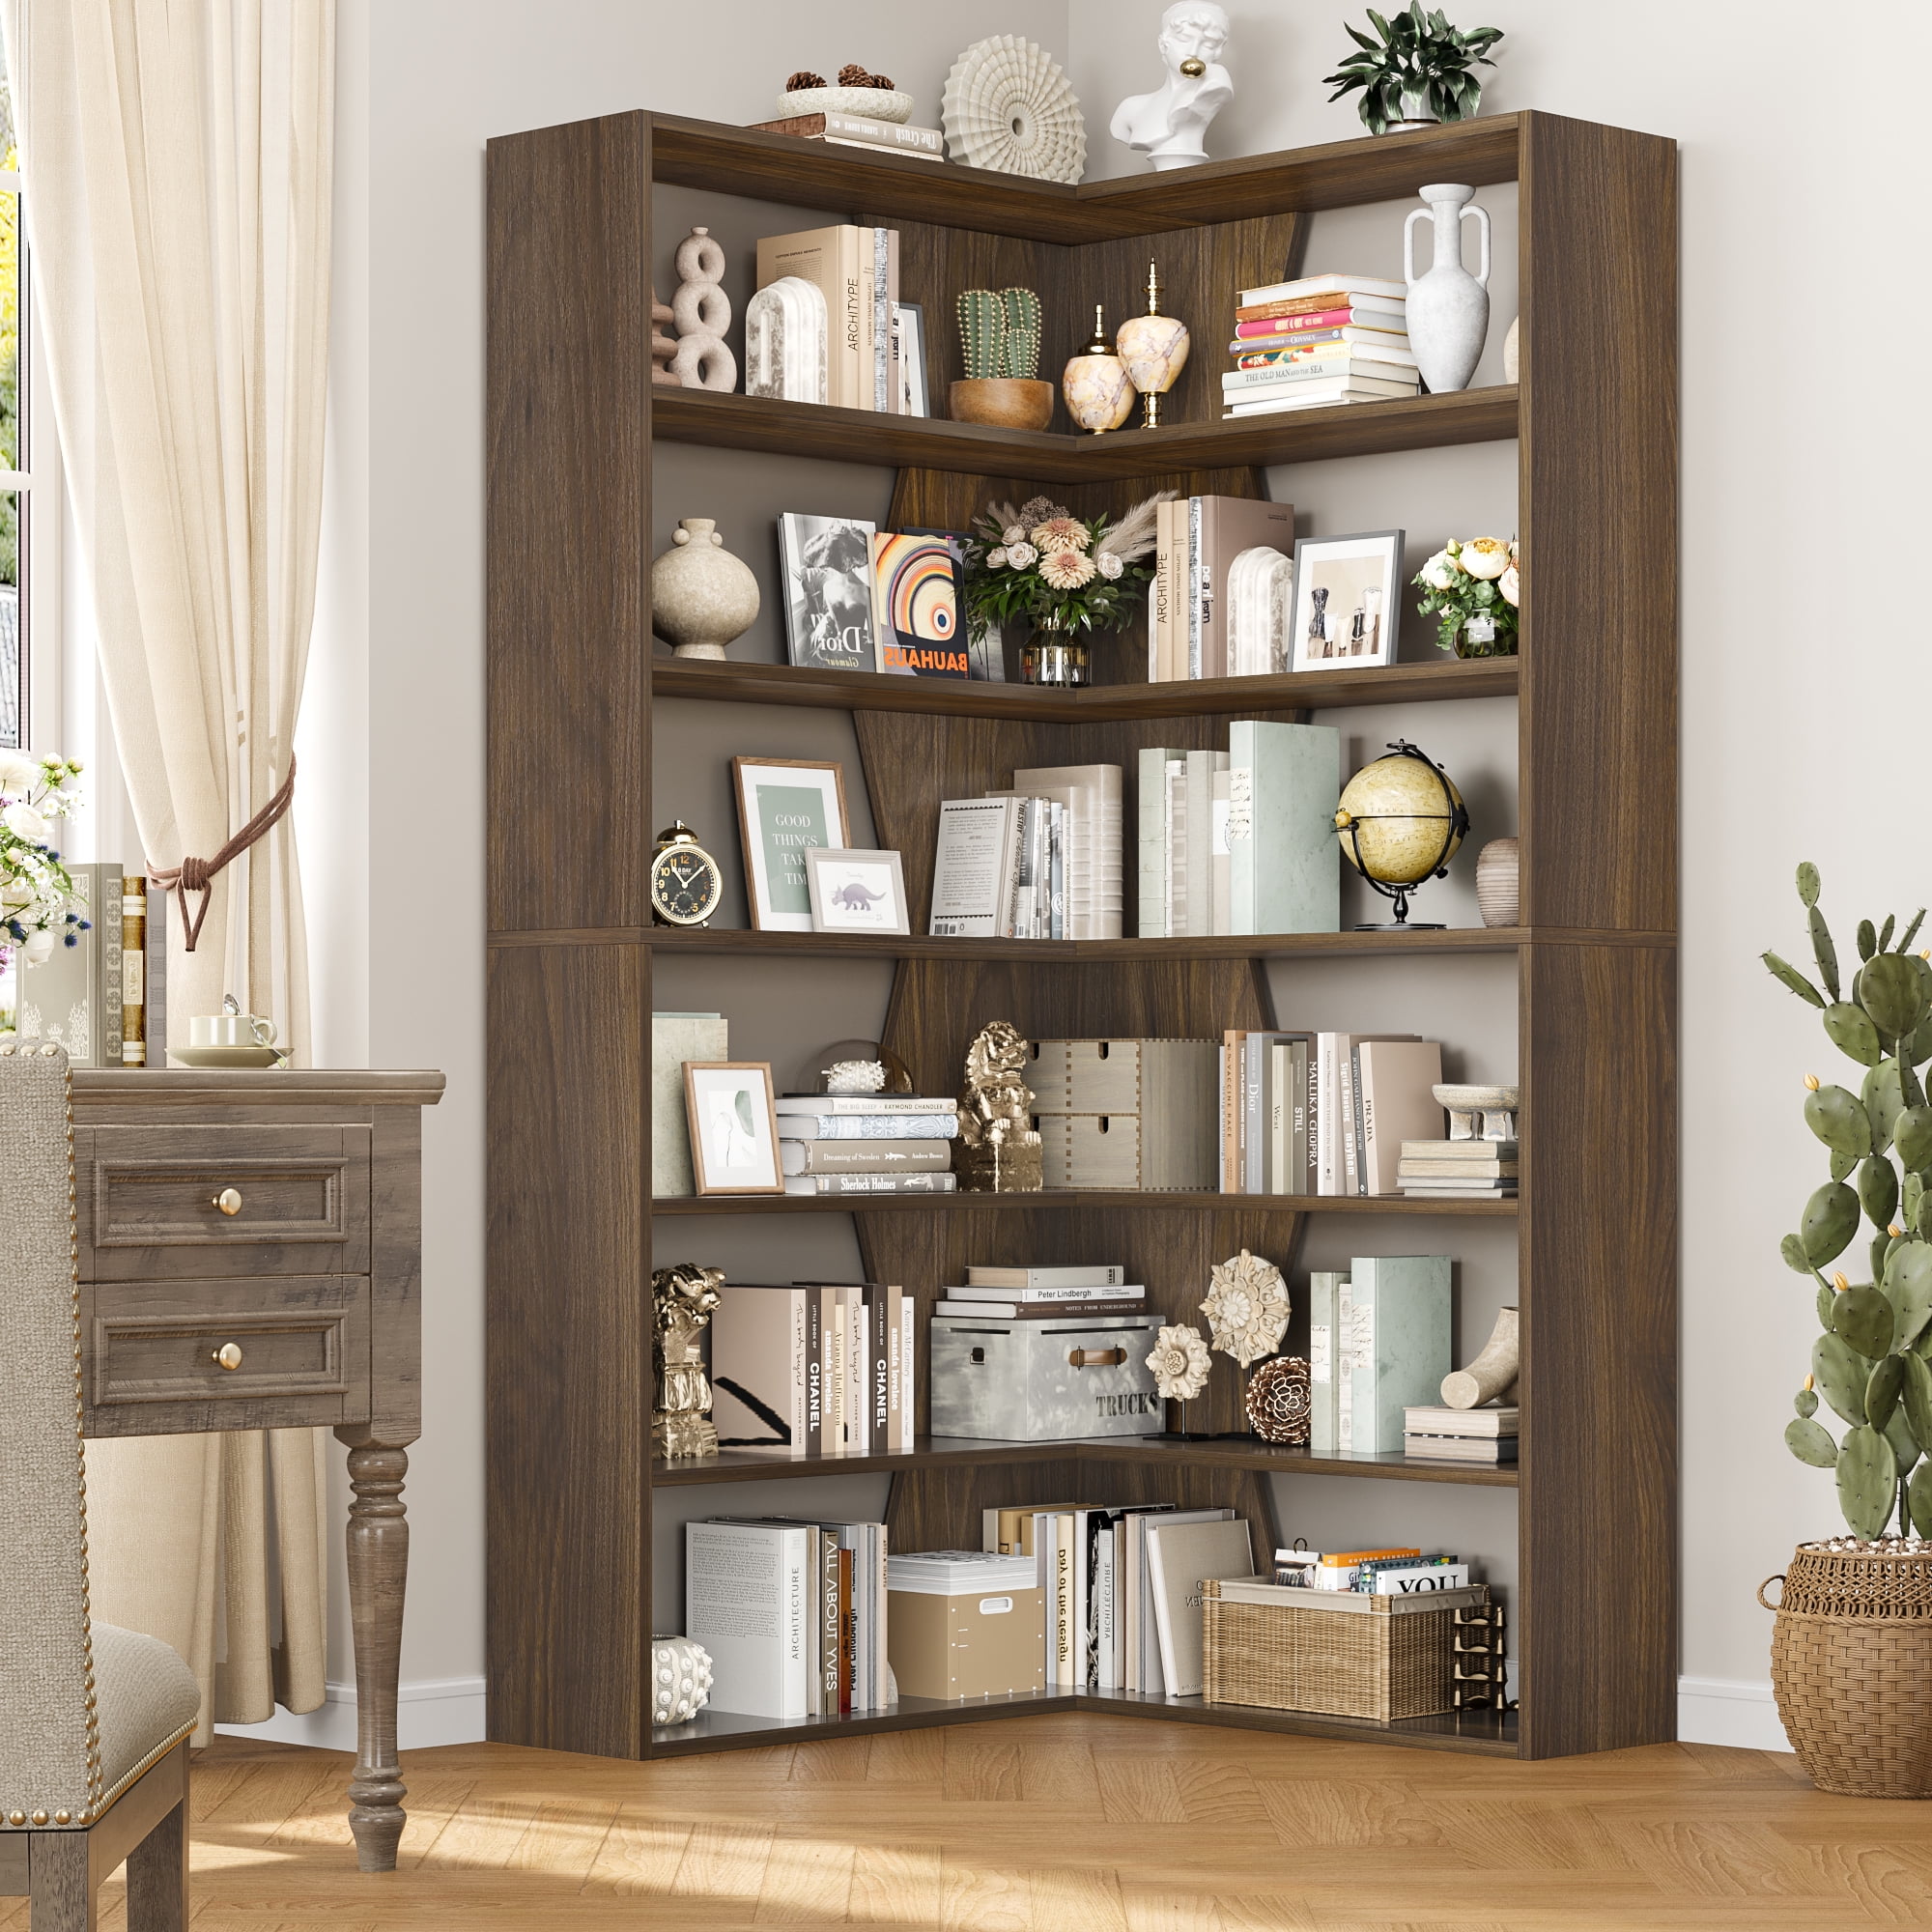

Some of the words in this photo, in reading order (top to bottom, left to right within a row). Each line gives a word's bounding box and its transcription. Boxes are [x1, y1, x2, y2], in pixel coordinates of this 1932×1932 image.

[895, 128, 920, 147] Crush
[921, 134, 936, 150] The
[847, 277, 859, 352] ARCHITYPE
[1245, 373, 1259, 383] THE
[1260, 371, 1274, 381] OLD
[1275, 368, 1291, 379] MAN
[1310, 365, 1323, 374] SEA
[1157, 553, 1167, 624] ARCHITYPE
[1202, 565, 1214, 598] pearl
[775, 814, 810, 828] GOOD
[1017, 804, 1026, 835] TOLSTOY
[773, 834, 818, 847] THINGS
[680, 855, 690, 865] 12
[781, 853, 806, 866] TAK
[661, 867, 670, 876] 10
[784, 873, 808, 885] TIM
[658, 880, 666, 889] 9
[662, 892, 668, 901] 8
[669, 901, 676, 911] 7
[692, 902, 699, 912] 5
[1340, 1062, 1350, 1087] Sigrid
[1248, 1083, 1259, 1114] Dior
[1309, 1061, 1318, 1114] MALLIKA
[1342, 1089, 1350, 1122] Rausing
[1294, 1106, 1303, 1134] STILL
[1309, 1120, 1318, 1168] CHOPRA
[1345, 1132, 1355, 1176] mayhem
[840, 1178, 870, 1191] Sherlock
[871, 1178, 895, 1190] Holmes
[1037, 1291, 1056, 1299] Peter
[1057, 1289, 1092, 1299] Lindbergh
[796, 1327, 805, 1349] body
[852, 1324, 861, 1346] body
[810, 1362, 820, 1432] CHANEL
[876, 1359, 887, 1429] CHANEL
[1095, 1392, 1158, 1417] TRUCKS
[826, 1540, 838, 1573] ALL
[1397, 1575, 1459, 1593] YOU
[826, 1577, 838, 1639] ABOUT
[826, 1646, 838, 1691] YVES
